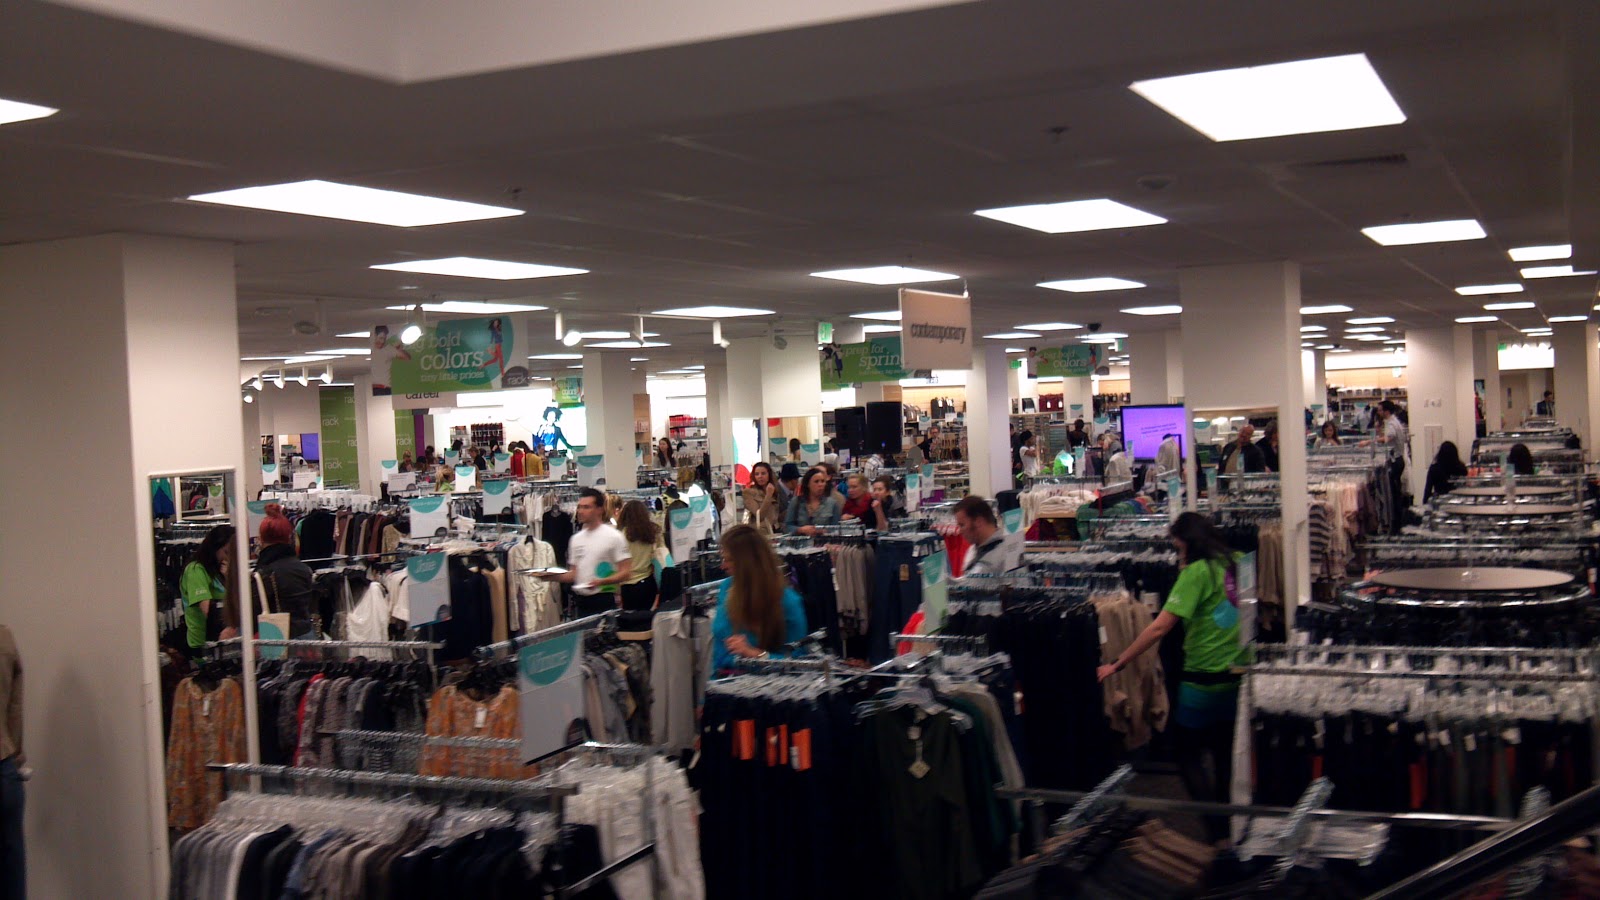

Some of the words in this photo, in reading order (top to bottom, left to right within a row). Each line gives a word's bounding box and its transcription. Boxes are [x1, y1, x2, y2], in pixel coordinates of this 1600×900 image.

[911, 321, 966, 344] contemporary
[844, 346, 869, 357] prep
[871, 344, 885, 354] for
[421, 348, 484, 371] colors
[859, 352, 901, 369] sprin
[1053, 358, 1087, 368] colors
[459, 370, 485, 380] prices
[507, 375, 527, 385] rack
[322, 417, 339, 427] rack
[396, 437, 412, 446] rack
[325, 460, 342, 470] rack
